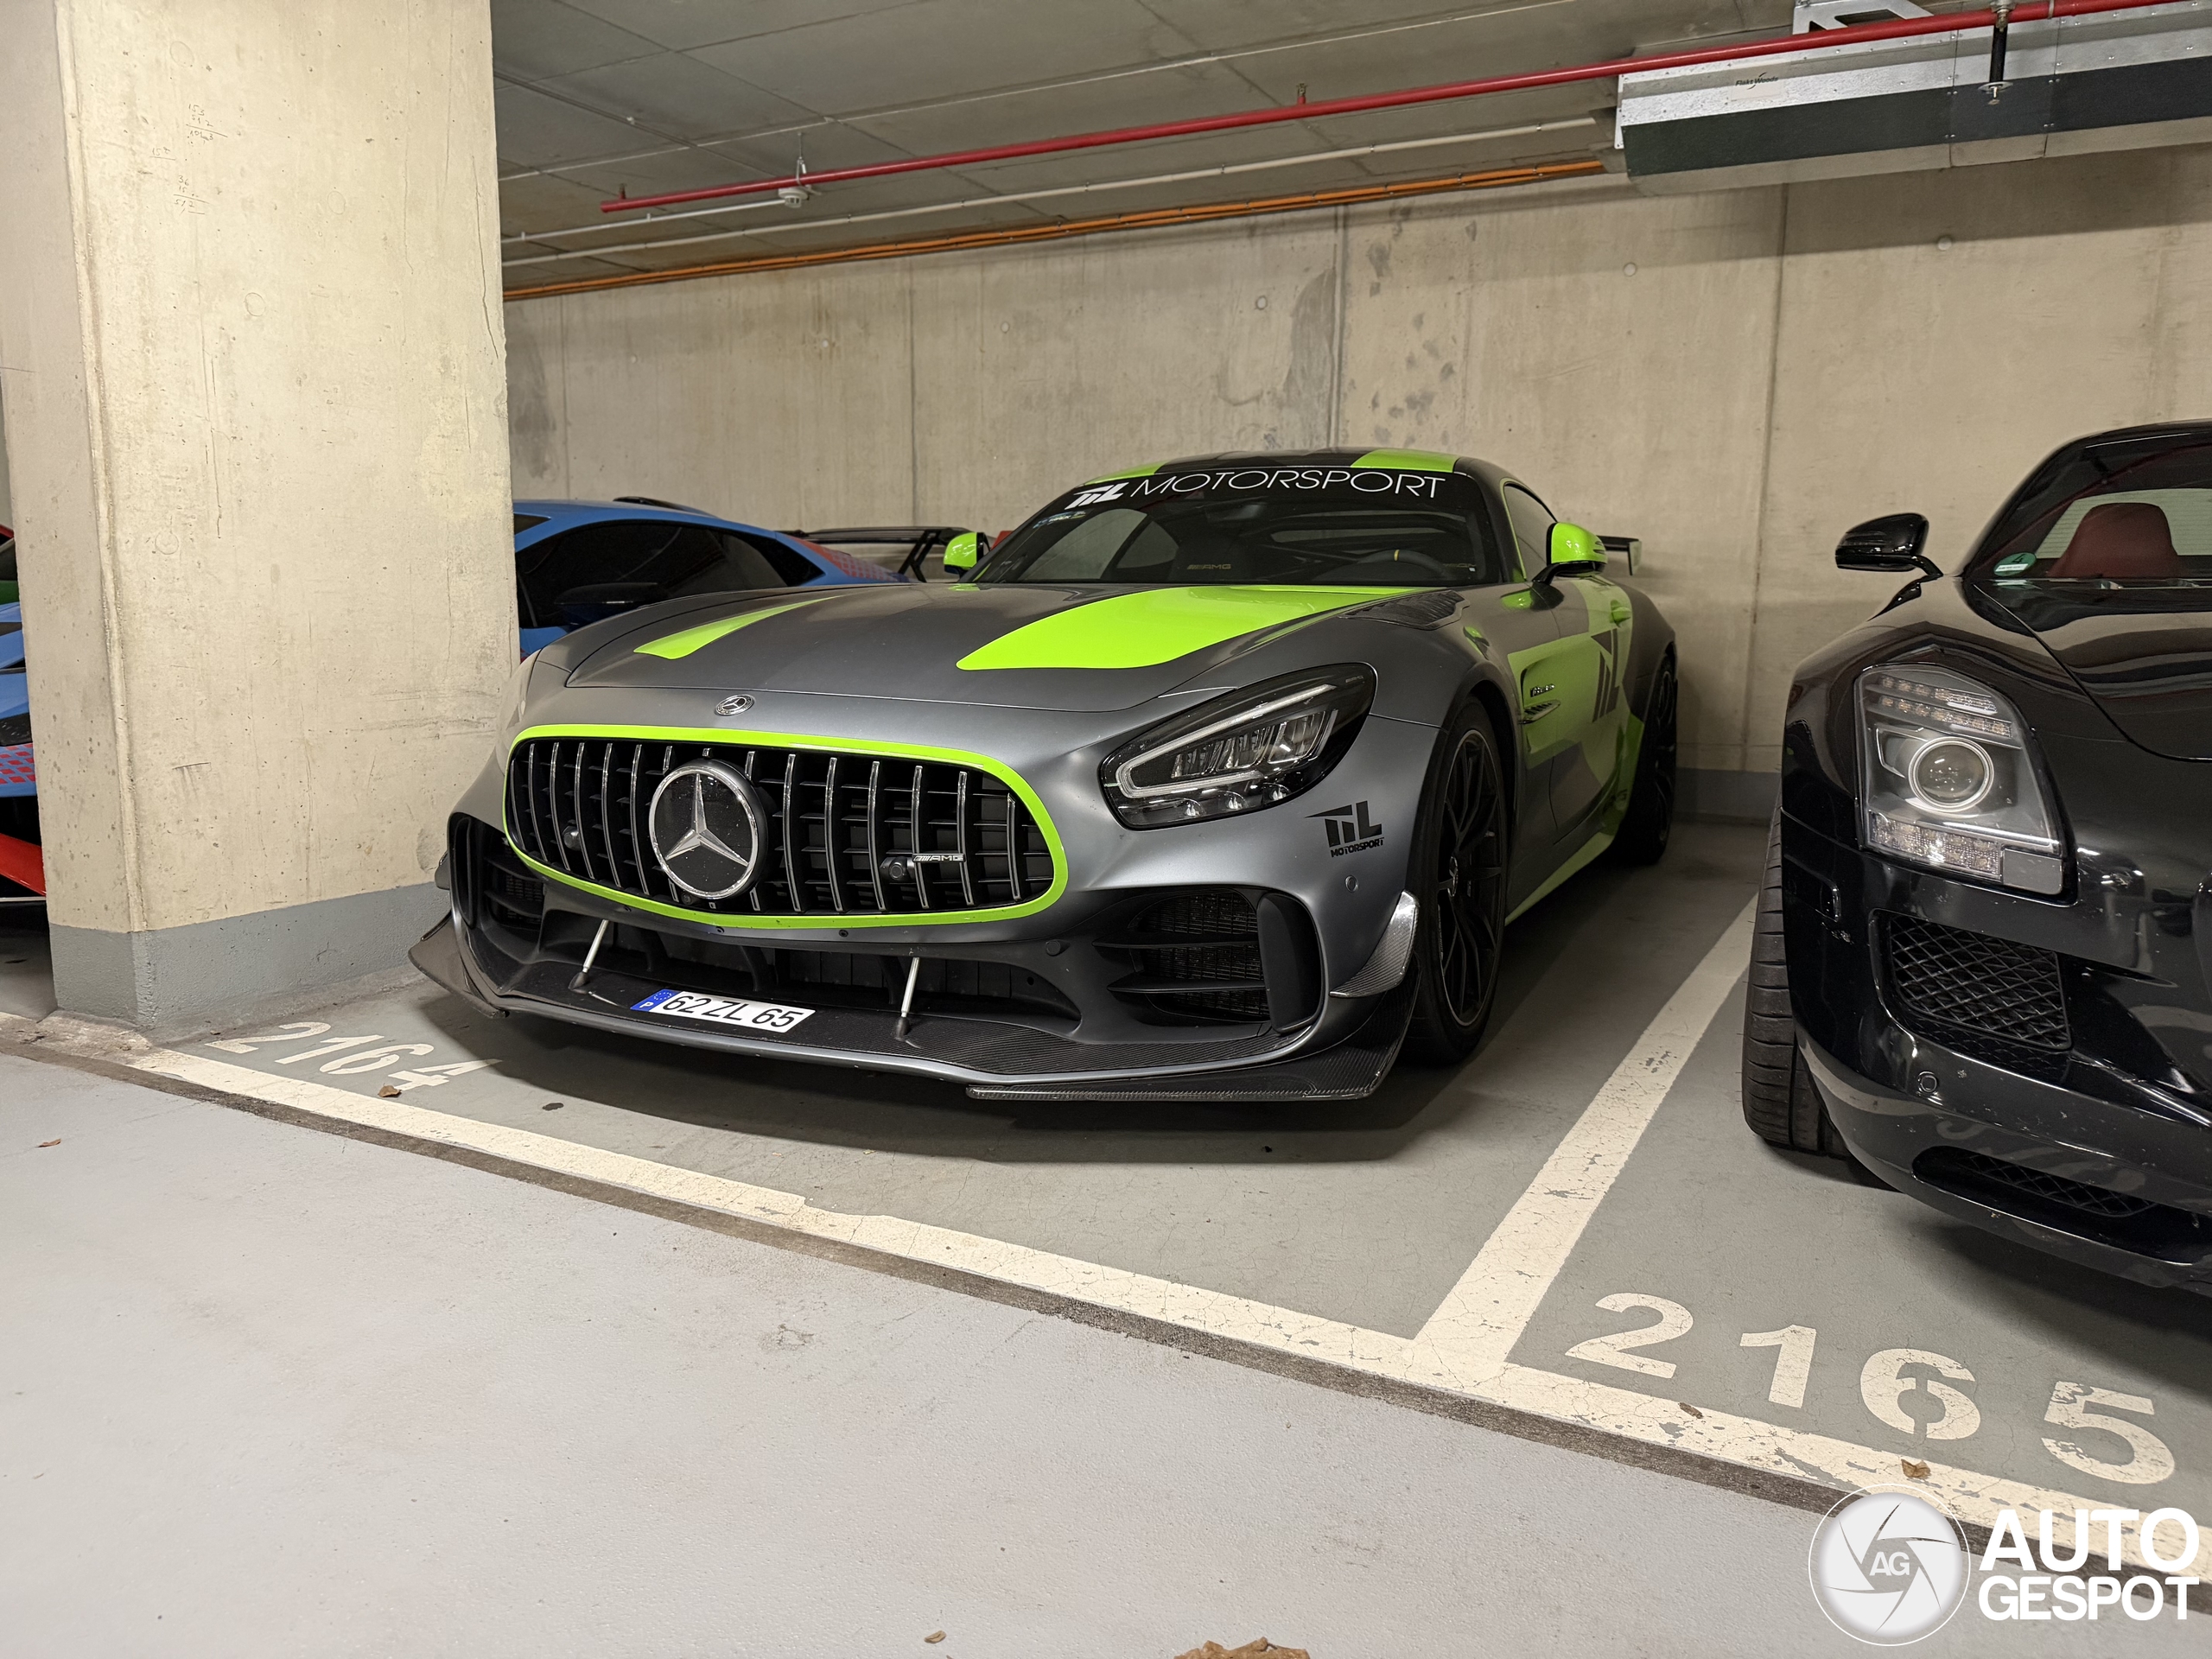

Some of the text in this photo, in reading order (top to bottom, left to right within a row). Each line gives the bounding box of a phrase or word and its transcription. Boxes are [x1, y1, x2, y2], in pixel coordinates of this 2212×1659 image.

[1130, 469, 1446, 499] MOTORSPORT
[1331, 836, 1385, 858] MOTORSPORT
[662, 995, 804, 1028] 62 ZL 65
[204, 1021, 504, 1091] 2164
[1564, 1292, 2176, 1484] 2165
